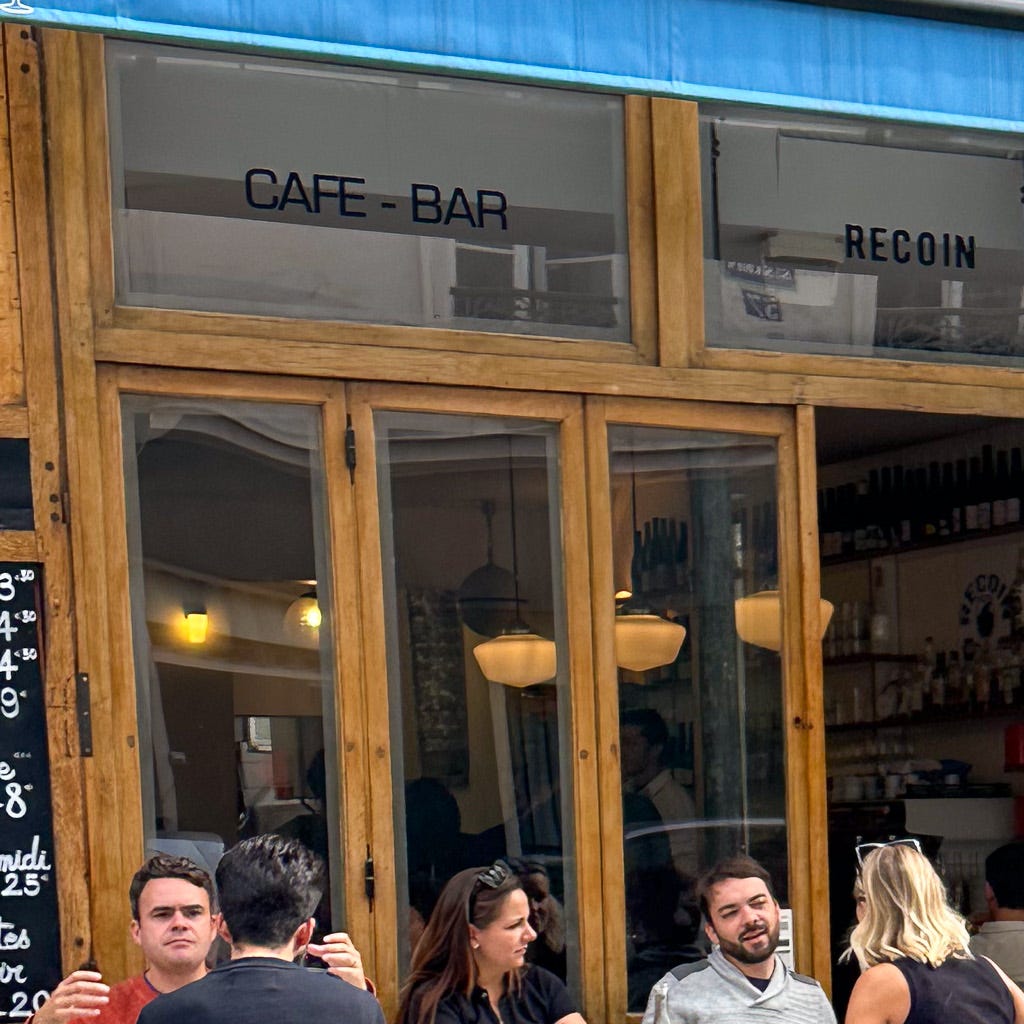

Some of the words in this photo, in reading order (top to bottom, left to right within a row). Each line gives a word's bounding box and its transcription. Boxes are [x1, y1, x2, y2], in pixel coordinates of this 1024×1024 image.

[245, 168, 366, 217] CAFE
[411, 183, 508, 230] BAR
[844, 224, 975, 269] RECOIN
